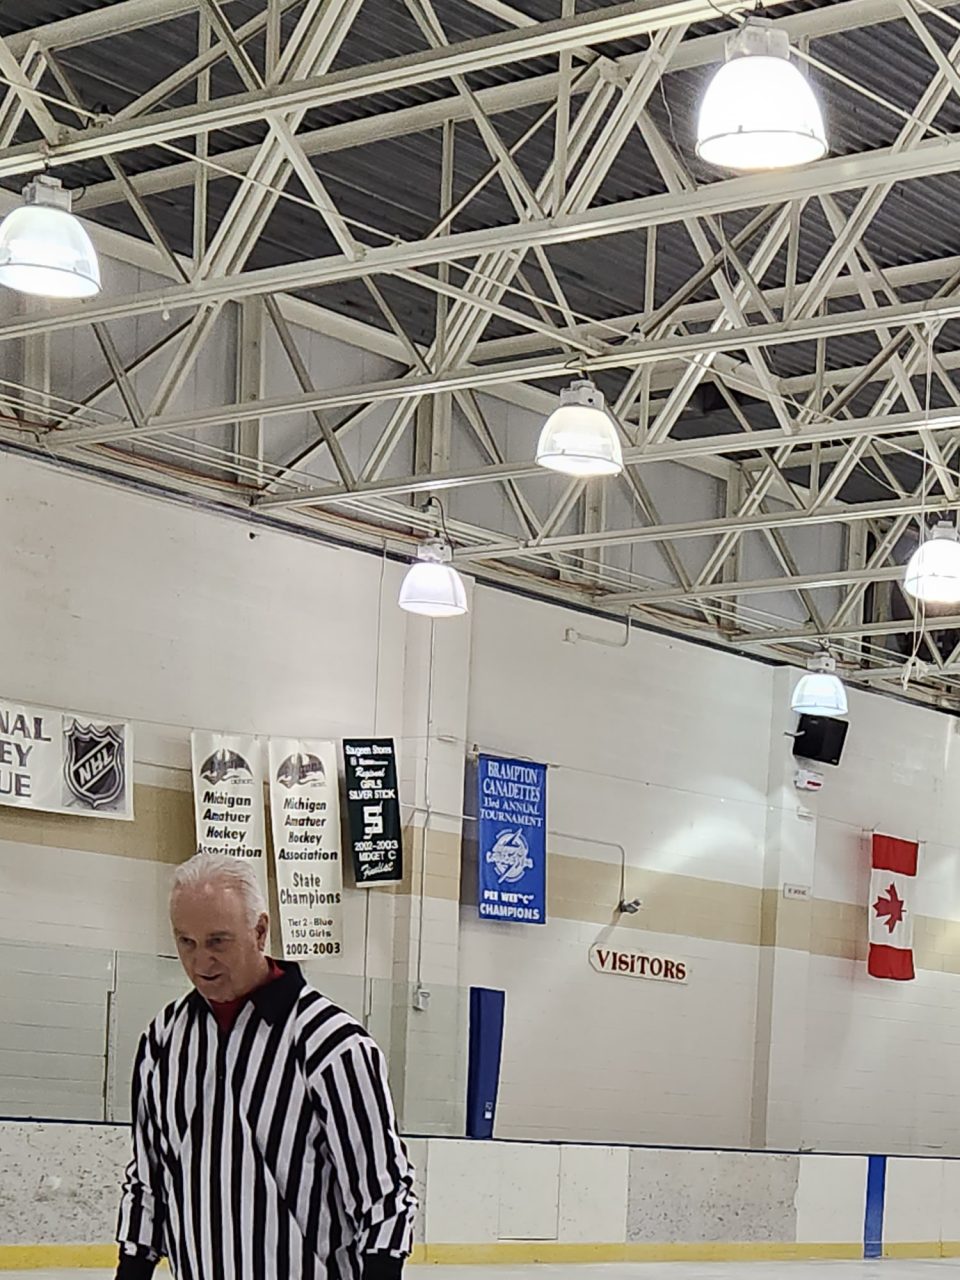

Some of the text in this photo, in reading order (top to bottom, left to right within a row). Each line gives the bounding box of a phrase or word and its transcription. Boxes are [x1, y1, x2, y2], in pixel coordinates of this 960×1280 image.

[78, 747, 114, 786] NHL
[488, 760, 538, 784] BRAMPTON
[360, 779, 382, 789] GIRLS
[483, 777, 541, 802] CANADETTES
[203, 791, 252, 808] Michigan
[348, 789, 396, 800] SILVER STICK
[283, 797, 327, 813] Michigan
[502, 800, 540, 815] ANNUAL
[480, 808, 543, 827] TOURNAMENT
[206, 826, 247, 842] Hockey
[288, 831, 323, 846] Hockey
[354, 840, 399, 851] 2002-2003
[278, 848, 338, 861] Association
[359, 850, 397, 861] MIDGET C
[292, 871, 321, 888] State
[280, 888, 341, 909] Champions
[480, 903, 540, 920] CHAMPIONS
[288, 918, 301, 926] Tier
[302, 918, 308, 926] 2
[313, 918, 333, 926] Blue
[309, 929, 332, 938] Girls
[286, 942, 341, 955] 2002-2003
